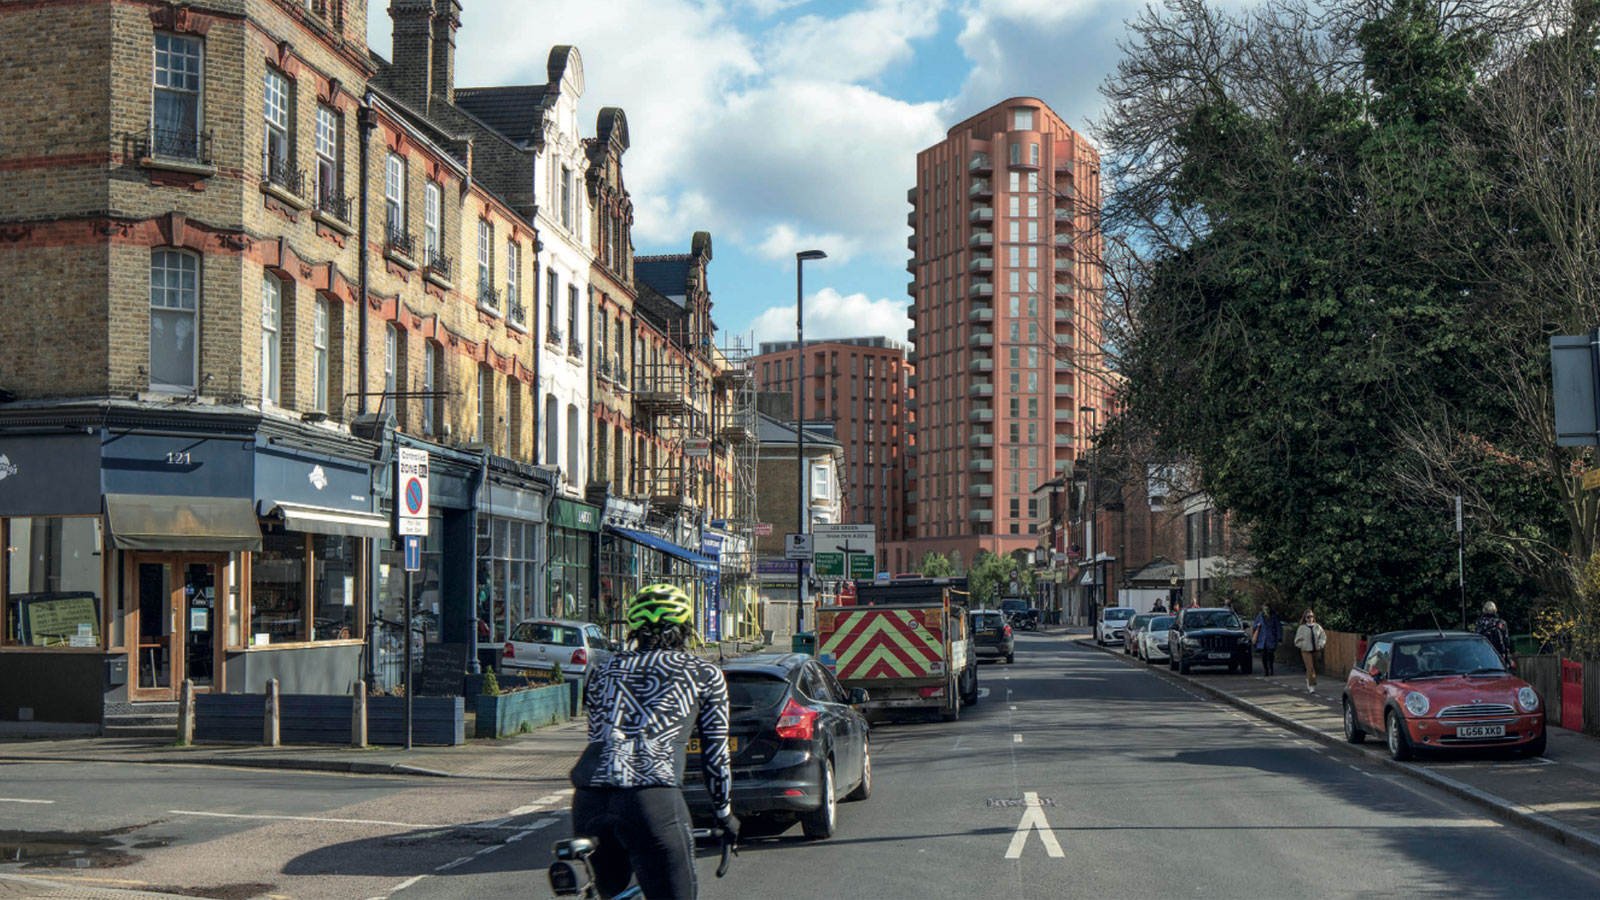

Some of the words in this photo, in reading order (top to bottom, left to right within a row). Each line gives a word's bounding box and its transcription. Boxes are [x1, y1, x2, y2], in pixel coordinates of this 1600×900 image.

[166, 451, 192, 465] 121
[401, 450, 426, 462] Controlled
[401, 463, 418, 475] ZONE
[1460, 727, 1483, 737] LG56
[1485, 726, 1502, 735] XKD
